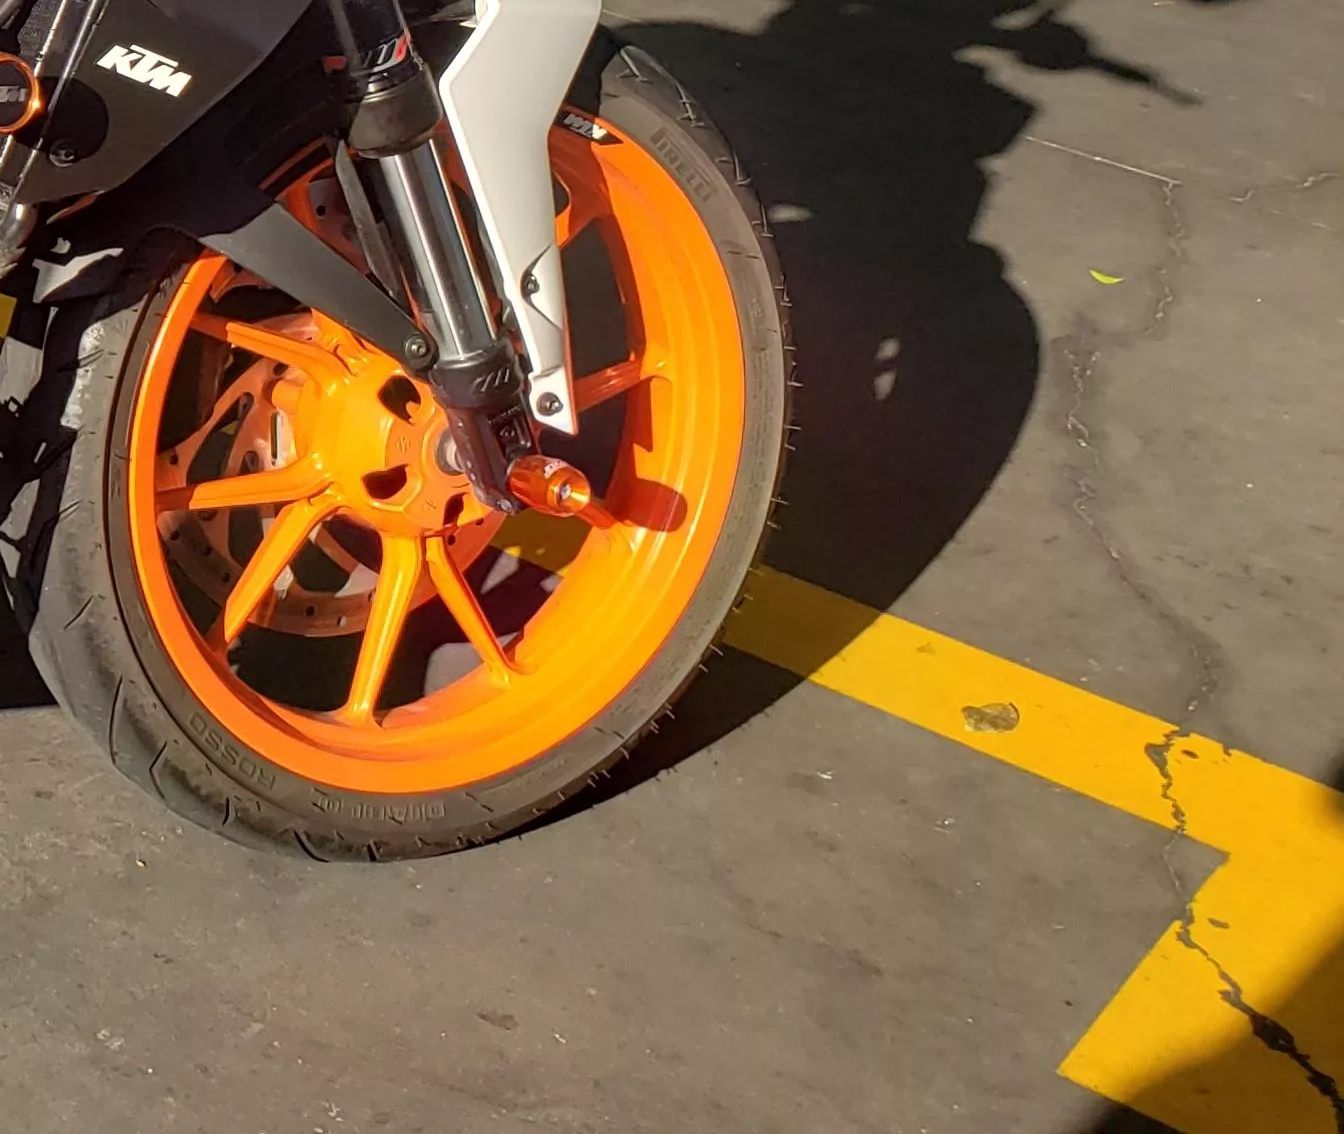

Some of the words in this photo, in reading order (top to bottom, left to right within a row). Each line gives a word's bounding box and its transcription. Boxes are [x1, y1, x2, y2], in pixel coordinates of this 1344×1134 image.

[96, 44, 193, 98] KTM
[562, 112, 608, 140] KTM
[649, 127, 718, 203] PIRELLI
[187, 711, 276, 791] ROSSO
